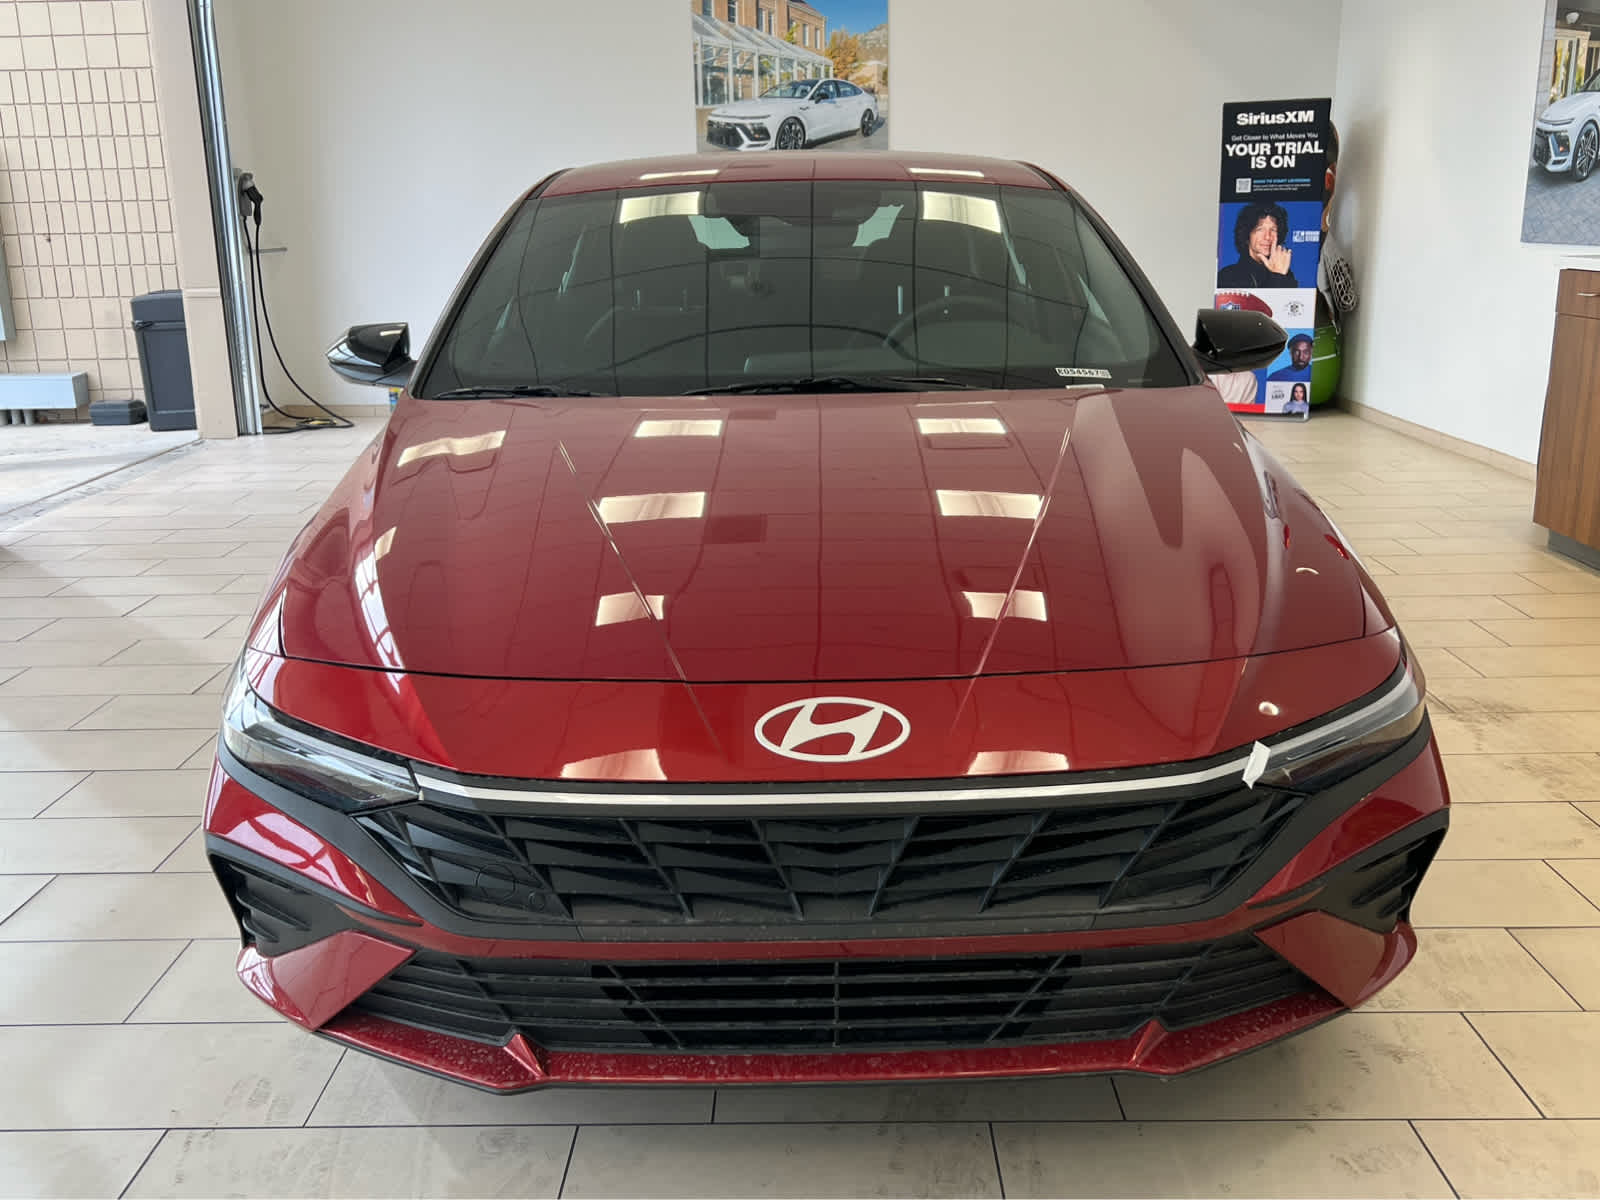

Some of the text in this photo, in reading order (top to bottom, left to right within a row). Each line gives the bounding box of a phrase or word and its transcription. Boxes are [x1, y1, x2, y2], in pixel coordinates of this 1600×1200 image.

[1236, 110, 1315, 125] SiriusXM
[1225, 141, 1323, 156] YOUR TRIAL
[1251, 155, 1296, 169] IS ON
